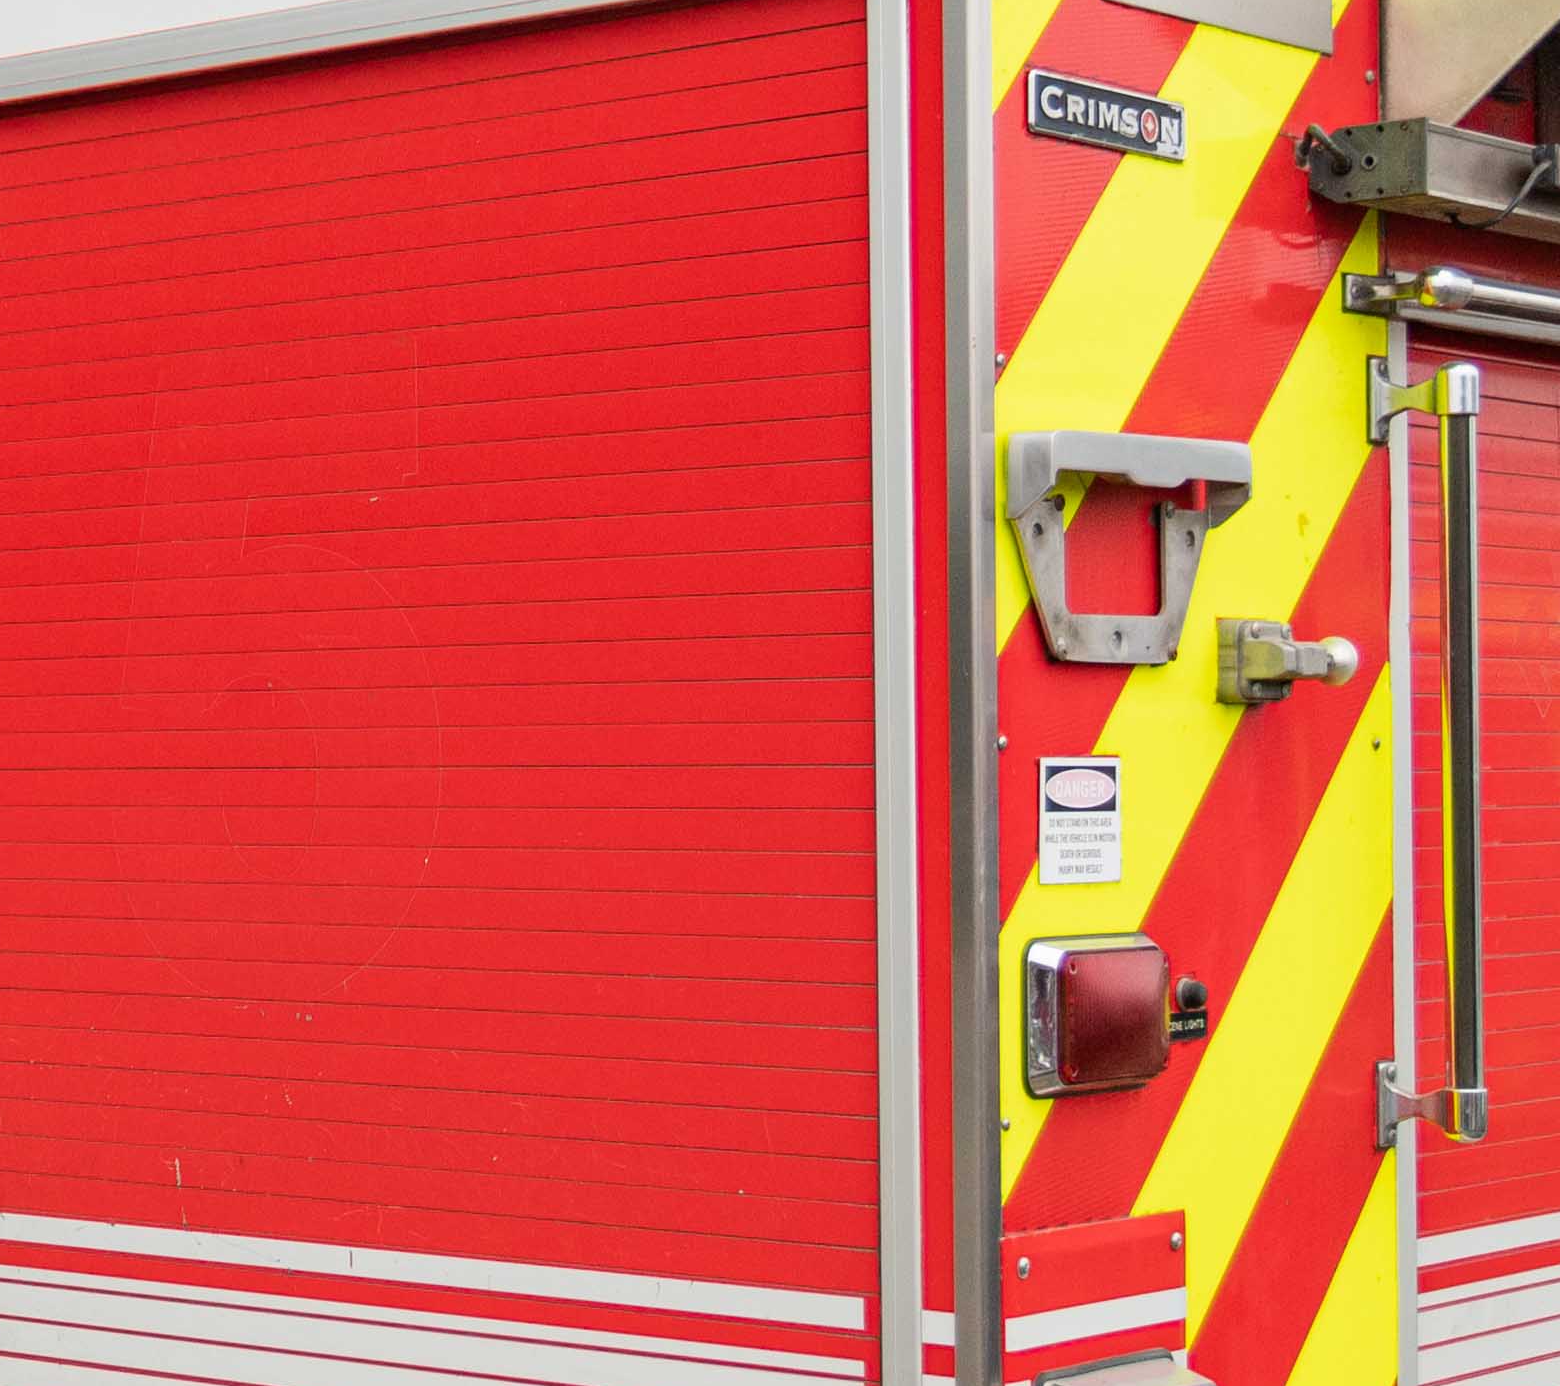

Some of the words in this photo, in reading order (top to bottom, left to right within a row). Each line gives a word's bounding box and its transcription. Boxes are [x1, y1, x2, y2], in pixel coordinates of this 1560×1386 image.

[1040, 84, 1180, 145] CRIMSON
[1055, 780, 1105, 798] DANGER
[1169, 1020, 1183, 1032] CENE
[1184, 1018, 1205, 1030] LIGHTS
